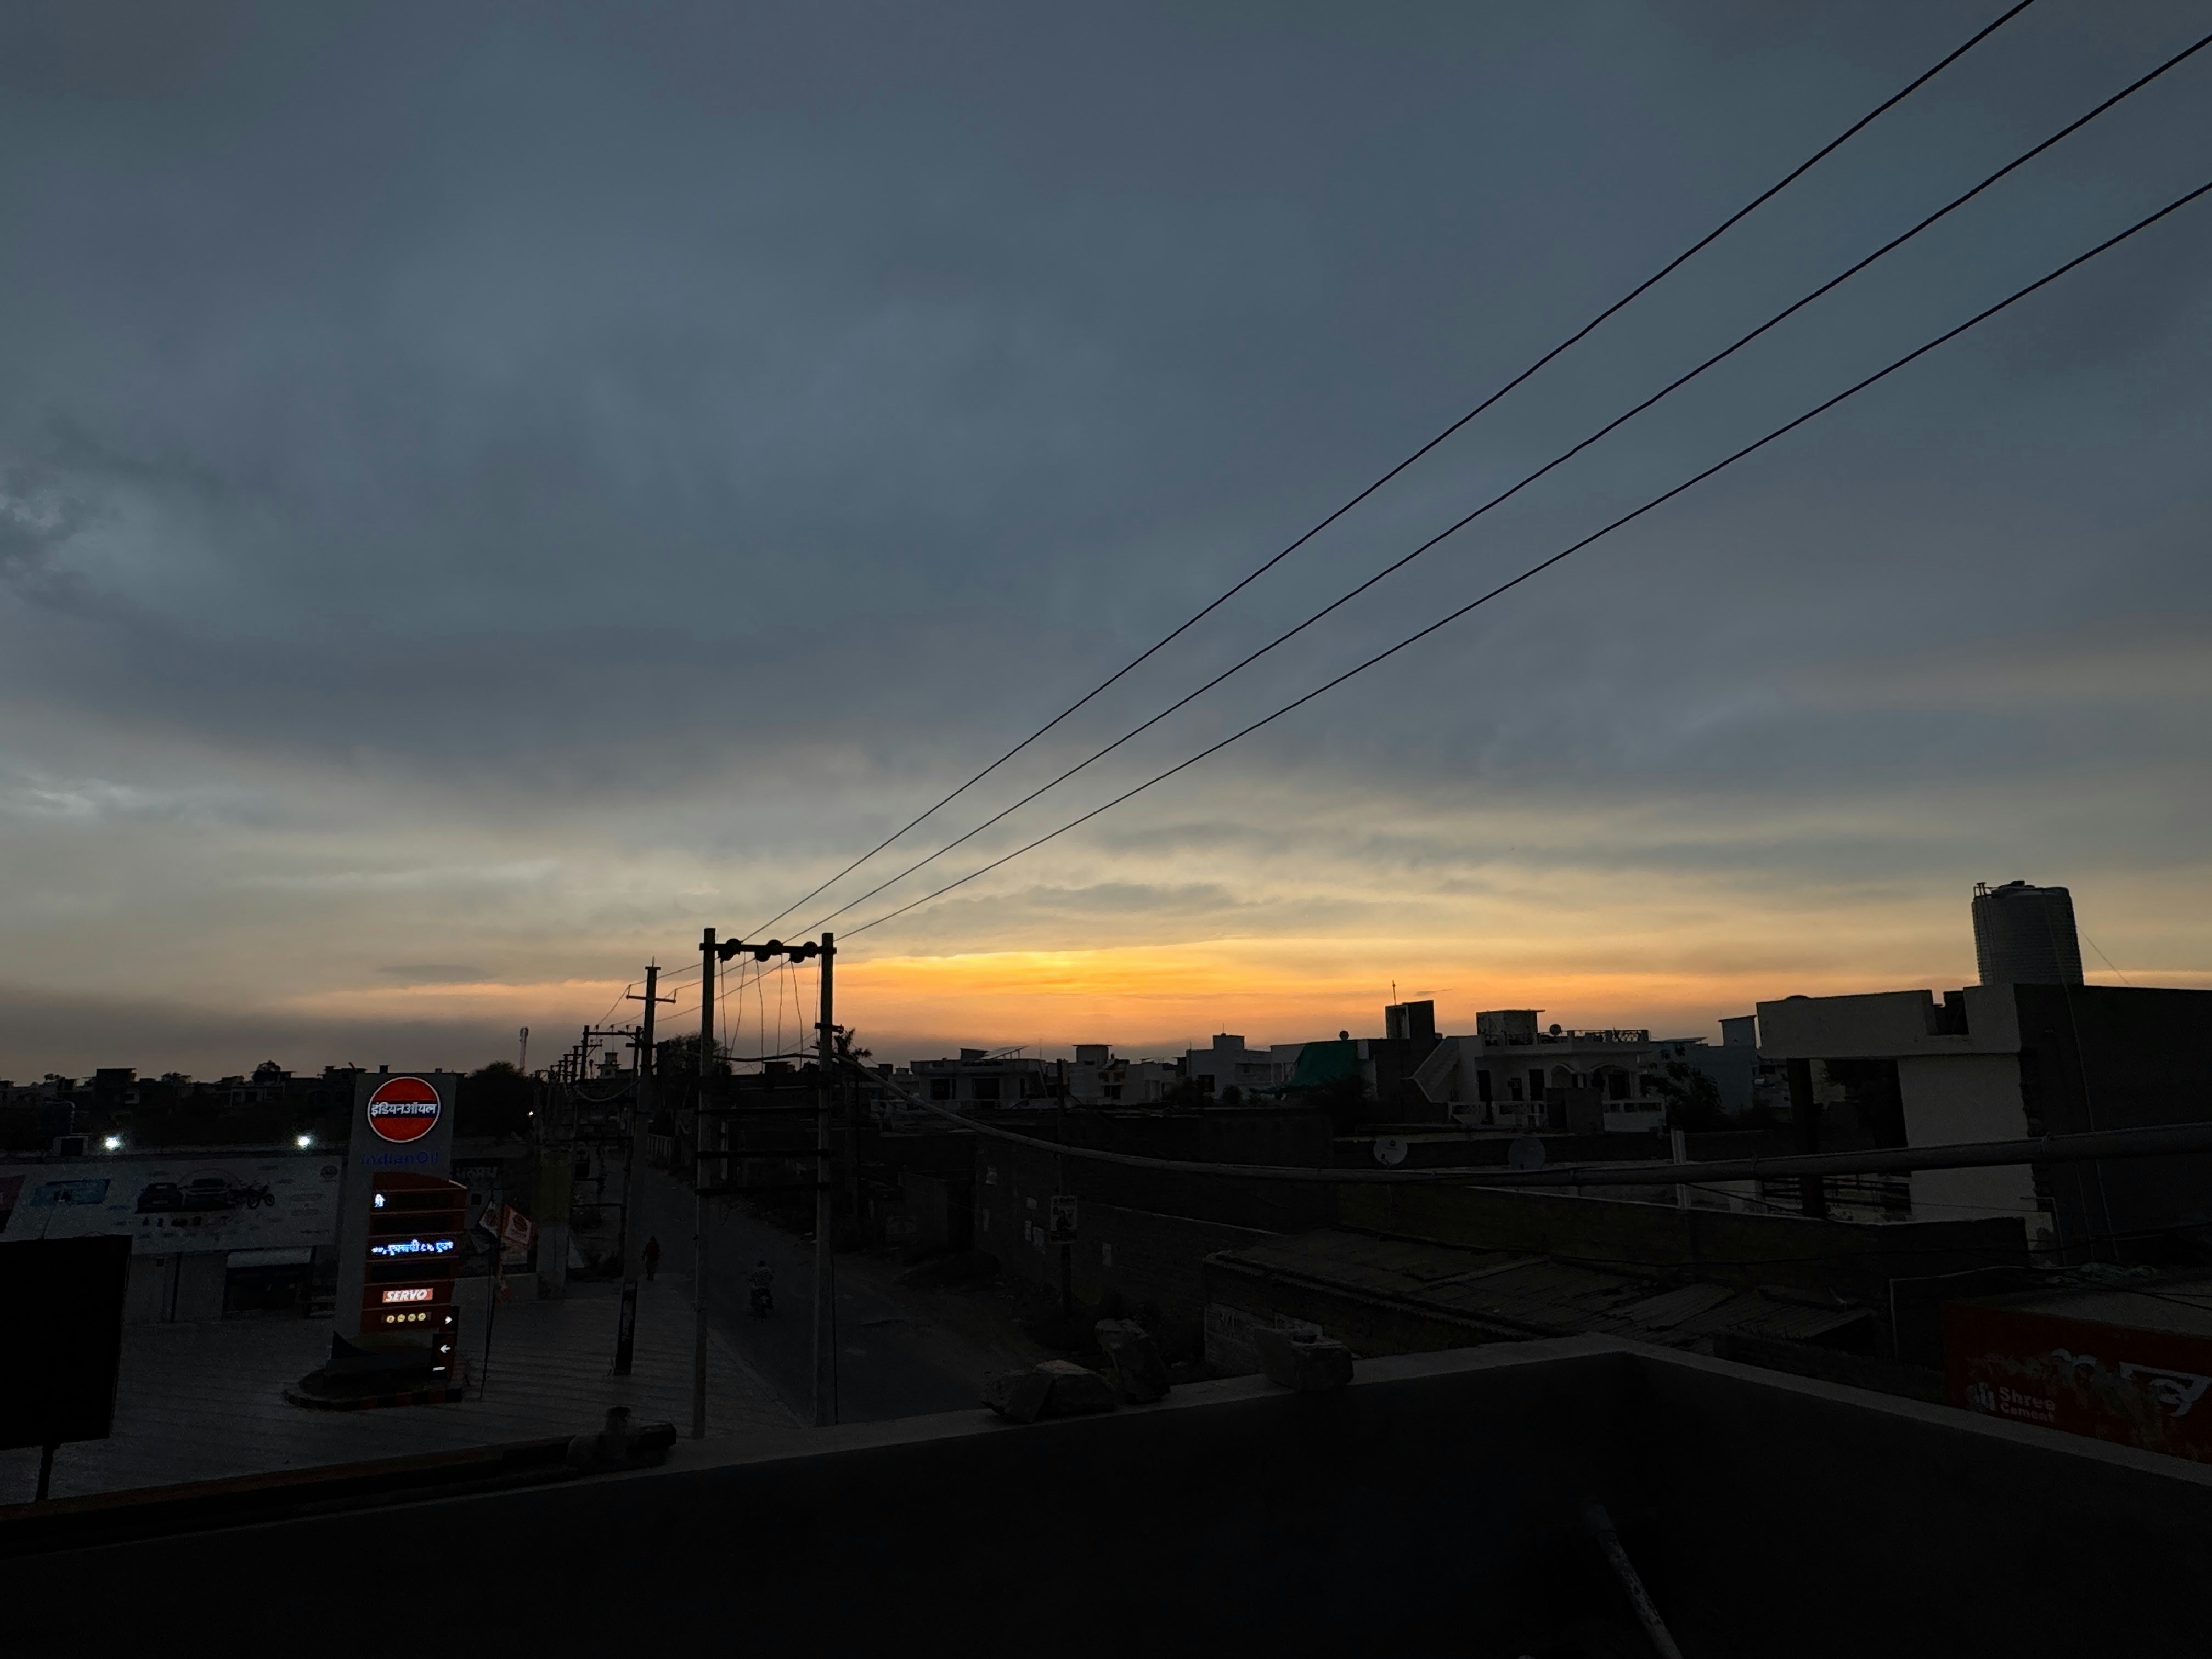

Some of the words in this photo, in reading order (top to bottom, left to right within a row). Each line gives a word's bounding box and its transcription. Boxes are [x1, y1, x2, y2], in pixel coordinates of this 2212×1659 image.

[371, 1102, 437, 1117] इंडियनऑयल
[385, 1289, 428, 1301] SERVO
[1999, 1386, 2056, 1412] Shree
